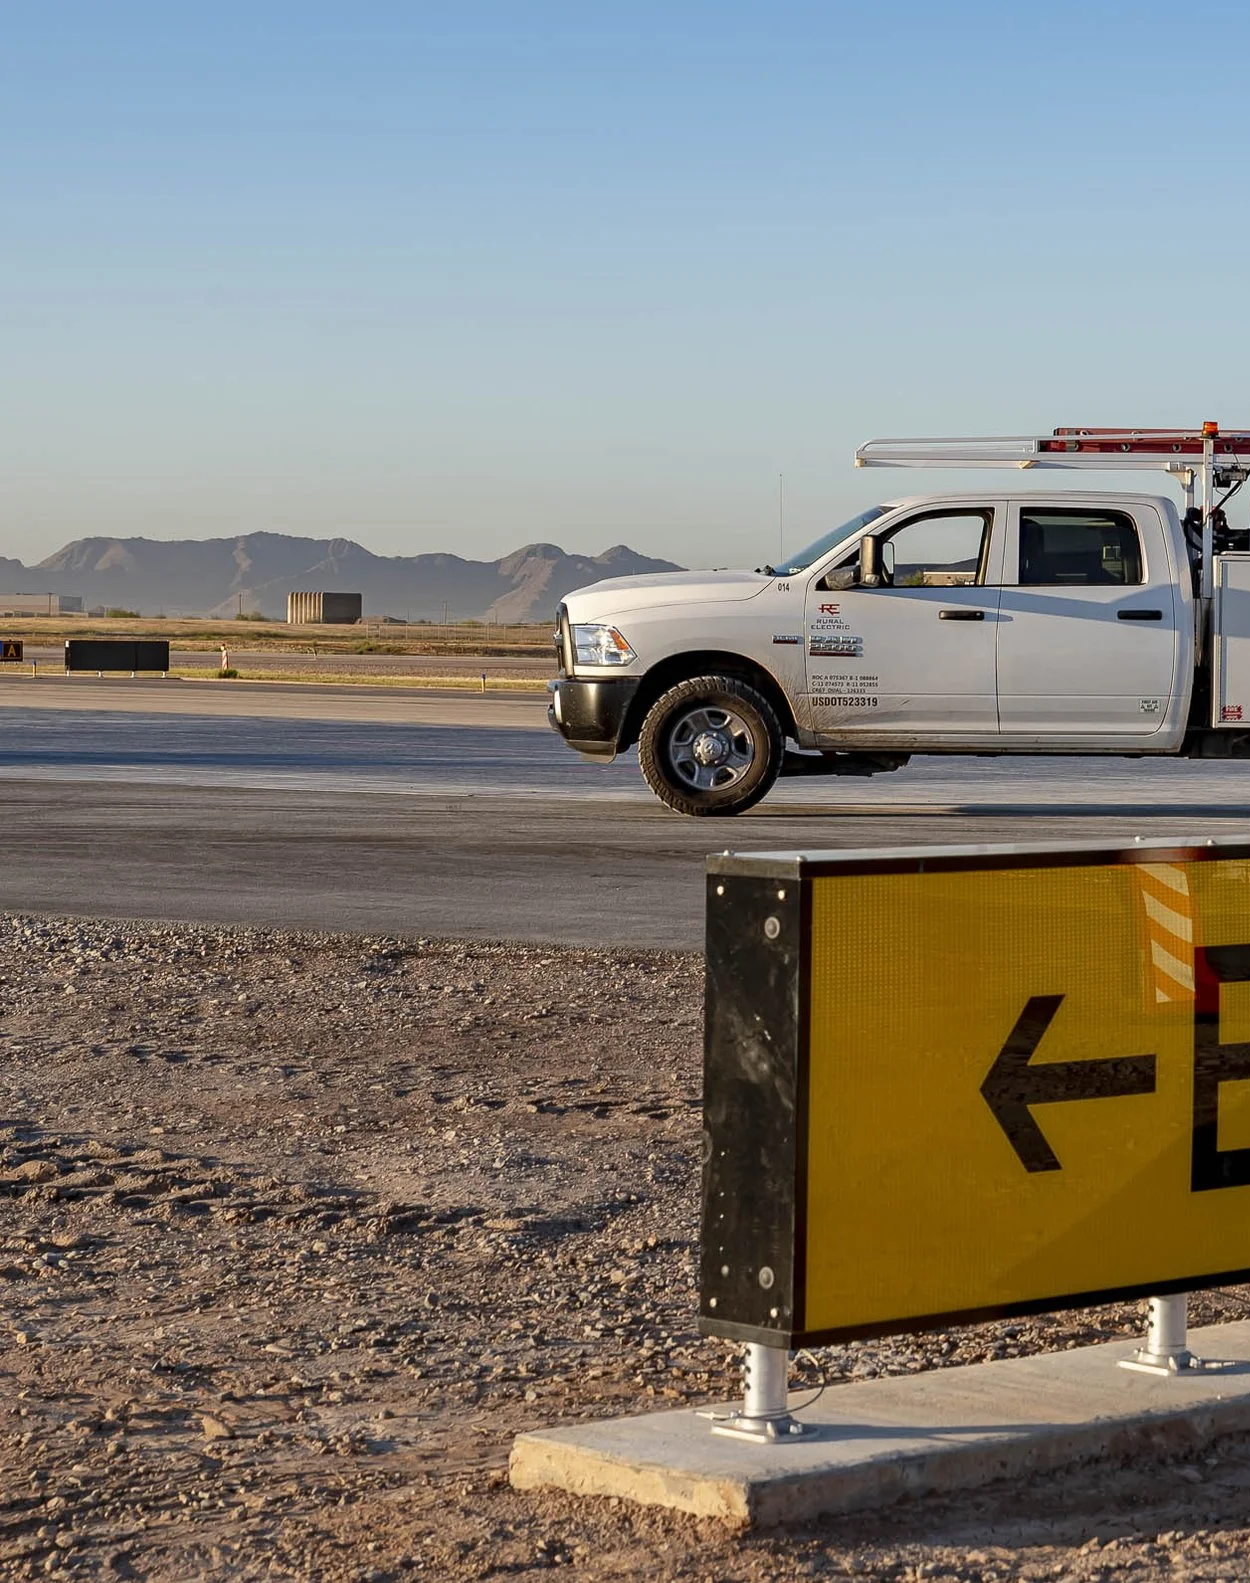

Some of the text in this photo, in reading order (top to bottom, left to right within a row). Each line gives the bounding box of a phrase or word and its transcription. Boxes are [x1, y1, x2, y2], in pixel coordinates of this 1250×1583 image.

[777, 582, 790, 592] 014
[7, 644, 16, 657] A
[812, 696, 878, 707] USDOT523319
